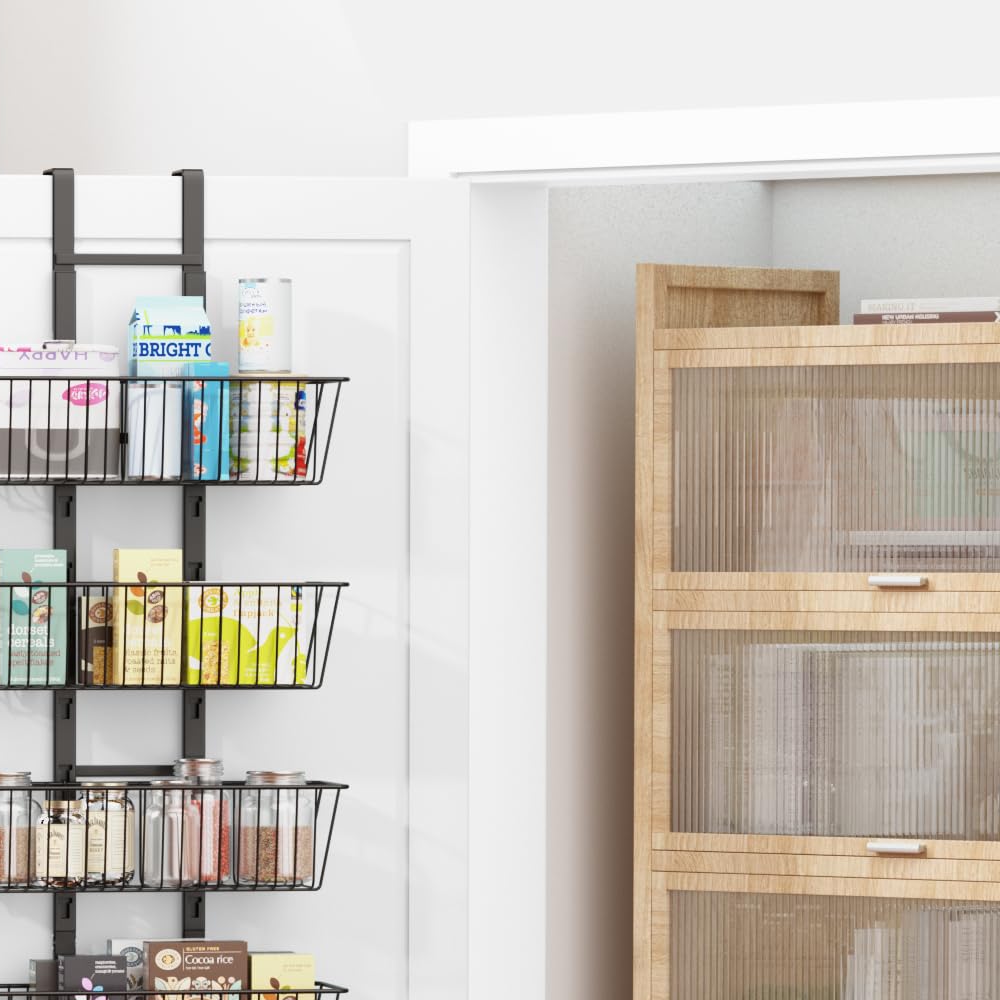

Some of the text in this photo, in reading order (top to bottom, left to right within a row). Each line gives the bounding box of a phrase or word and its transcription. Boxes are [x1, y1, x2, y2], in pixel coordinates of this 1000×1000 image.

[139, 342, 201, 357] BRIGHT
[185, 955, 214, 964] Cocoa
[216, 954, 233, 964] rice
